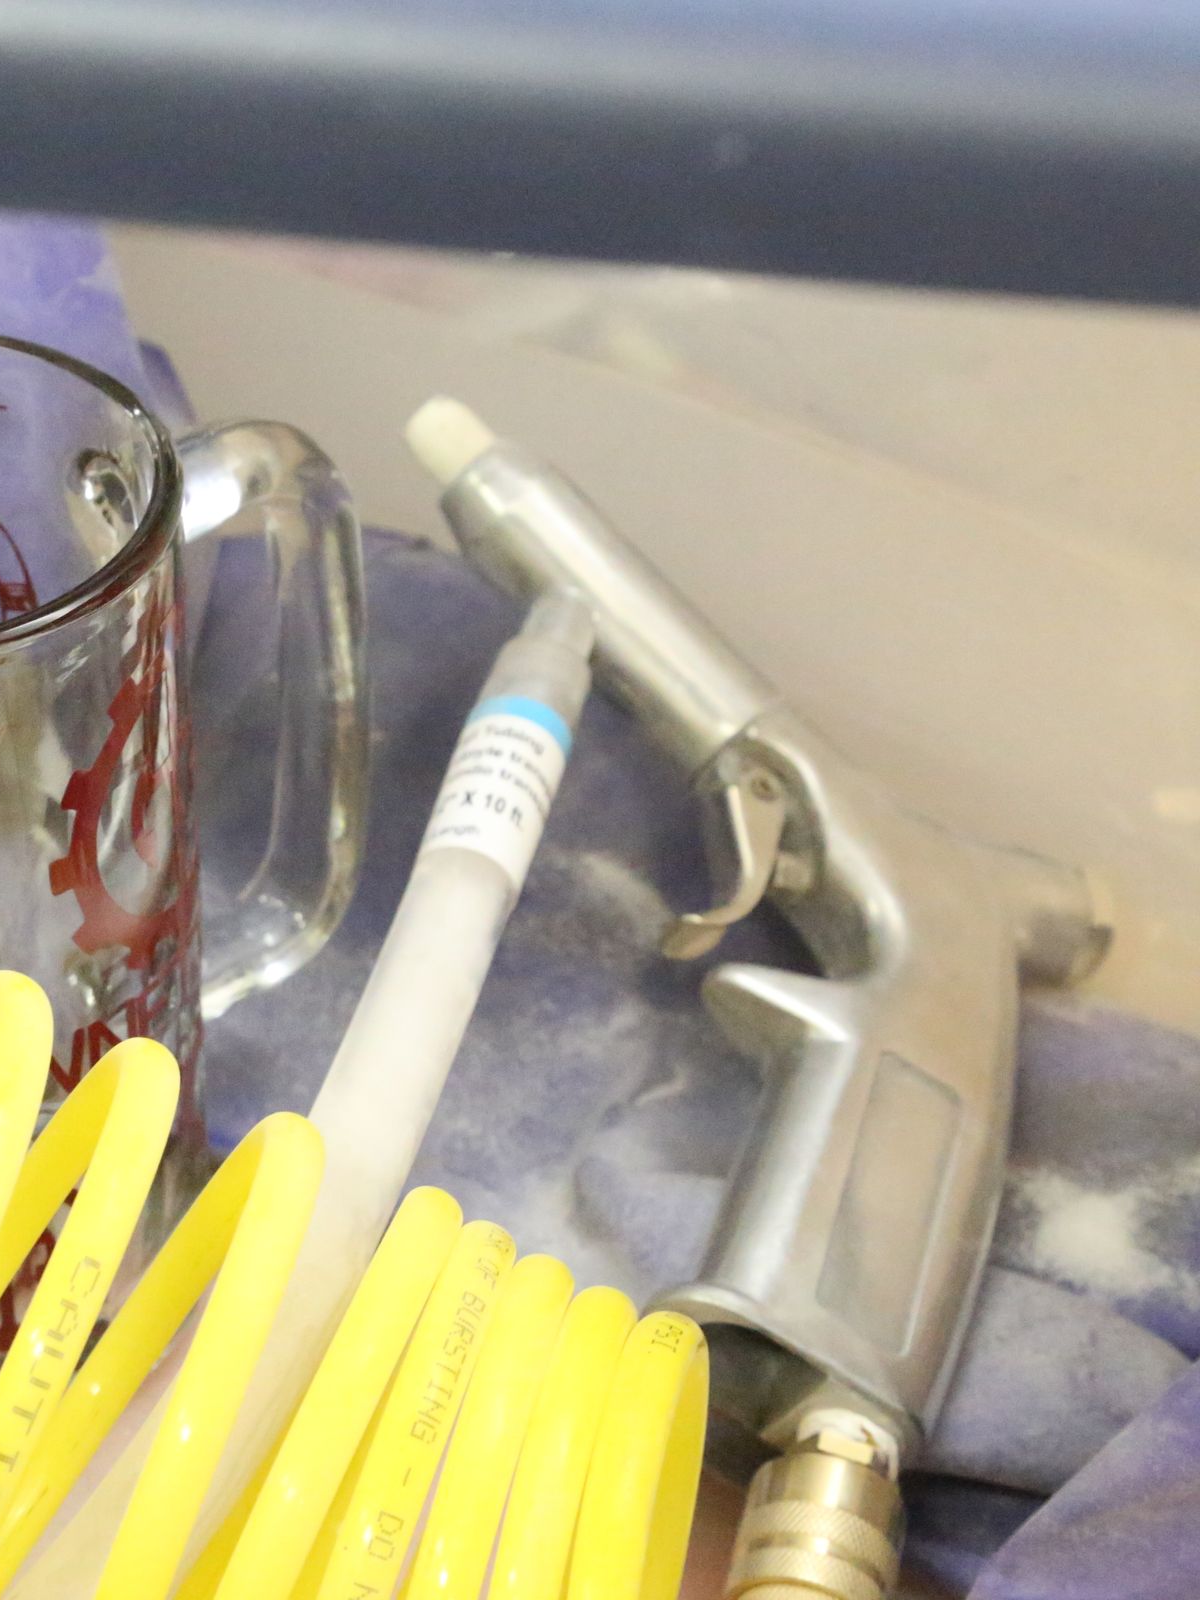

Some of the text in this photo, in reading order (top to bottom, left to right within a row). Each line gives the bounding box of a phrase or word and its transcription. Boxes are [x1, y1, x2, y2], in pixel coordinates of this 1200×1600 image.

[485, 793, 506, 814] 10
[409, 1290, 486, 1446] BURSTING
[367, 1510, 405, 1562] DO
